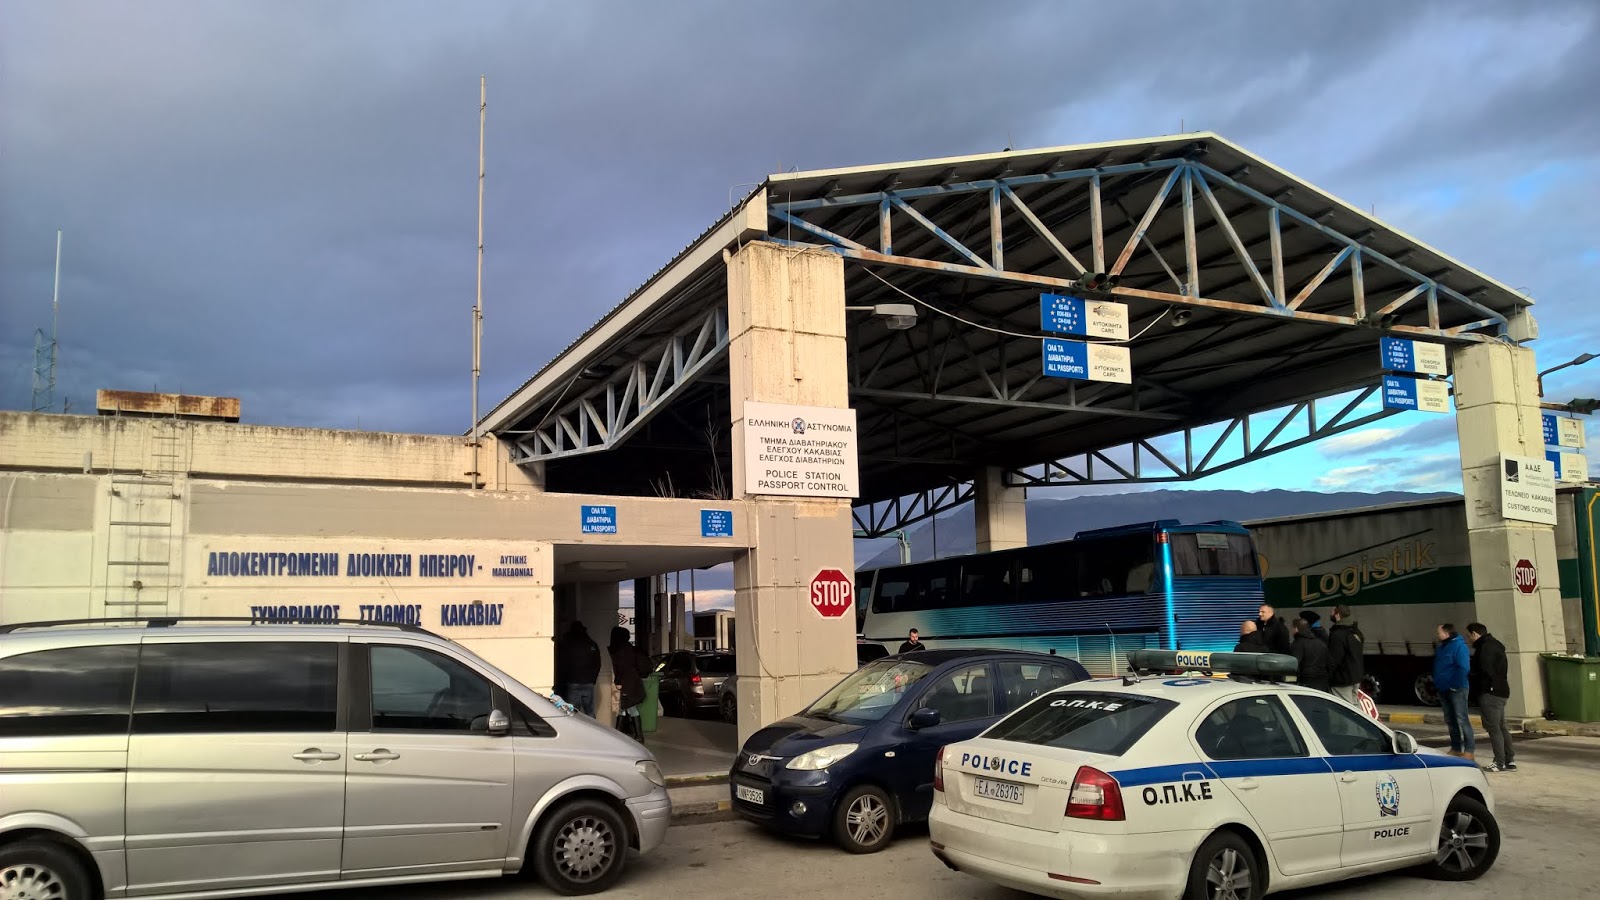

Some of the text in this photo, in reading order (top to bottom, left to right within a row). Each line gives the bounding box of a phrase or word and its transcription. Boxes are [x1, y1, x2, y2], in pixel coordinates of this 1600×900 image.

[1047, 344, 1057, 352] ΟΛΑ
[1048, 363, 1084, 374] ALL PASSPORTS
[748, 419, 852, 433] ΕΛΛΗΝΙΚΗ ΑΣΤΥΝΟΜΙΑ
[760, 437, 848, 449] ΤΜΗΜΑ ΔΙΑΒΑΤΗΡΙΑΚΟΥ
[766, 446, 842, 457] ΕΛΕΓΧΟΥ ΚΑΚΑΒΙΑΣ
[759, 454, 845, 466] ΕΛΕΓΧΟΣ ΔΙΑΒΑΤΗΡΙΩΝ
[1525, 463, 1541, 473] ΑΑΔΕ
[766, 470, 841, 481] POLICE STATION
[758, 480, 849, 492] PASSPORT CONTROL
[1507, 502, 1554, 516] CUSTOMS CONTROL
[591, 525, 616, 533] PASSPORTS
[207, 551, 339, 577] ΑΠΟΚΕΝΤΡΩΜΕΝΗ
[346, 553, 412, 577] ΔΙΟΙΚΗΣΗ
[499, 555, 528, 565] ΔΥΤΙΚΗΣ
[492, 567, 534, 577] ΜΑΚΕΔΟΝΙΑΣ
[1301, 540, 1436, 601] Logistik
[1515, 567, 1536, 586] STOP
[812, 580, 851, 607] STOP
[441, 603, 504, 627] ΚΑΚΑΒΙΑΣ
[1177, 655, 1209, 667] POLICE
[961, 752, 1032, 777] POLICE
[1373, 827, 1410, 840] POLICE
